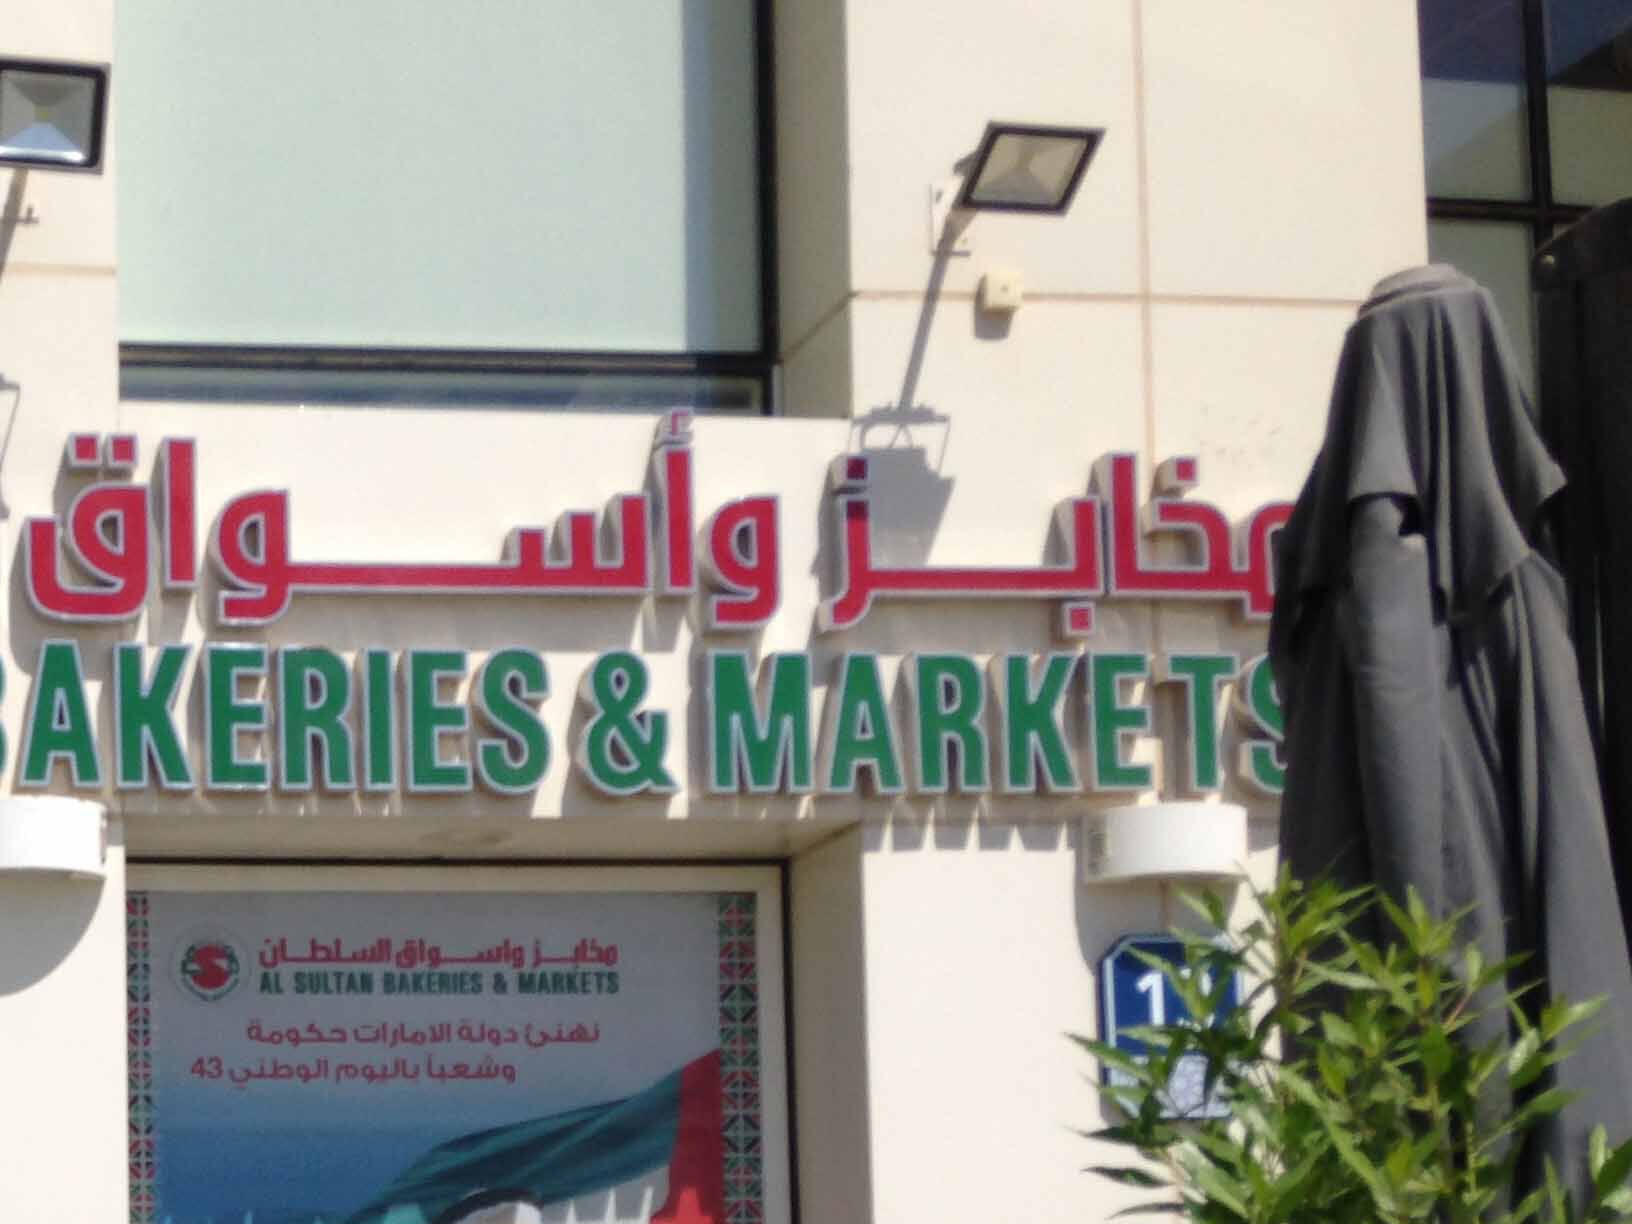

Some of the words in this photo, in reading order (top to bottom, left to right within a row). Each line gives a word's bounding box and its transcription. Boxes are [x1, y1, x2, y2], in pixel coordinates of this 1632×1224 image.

[583, 650, 680, 796] &
[259, 937, 392, 969] السلطان
[533, 937, 619, 969] مخابز
[259, 972, 284, 993] AL
[294, 972, 373, 994] SULTAN
[383, 972, 483, 994] BAKERIES
[493, 972, 508, 994] &
[518, 972, 619, 995] MARKETS
[247, 1018, 348, 1047] حكومة
[457, 1018, 518, 1046] دولة
[190, 1056, 224, 1080] 43
[228, 1057, 329, 1090] الوطني
[335, 1057, 419, 1086] باليوم
